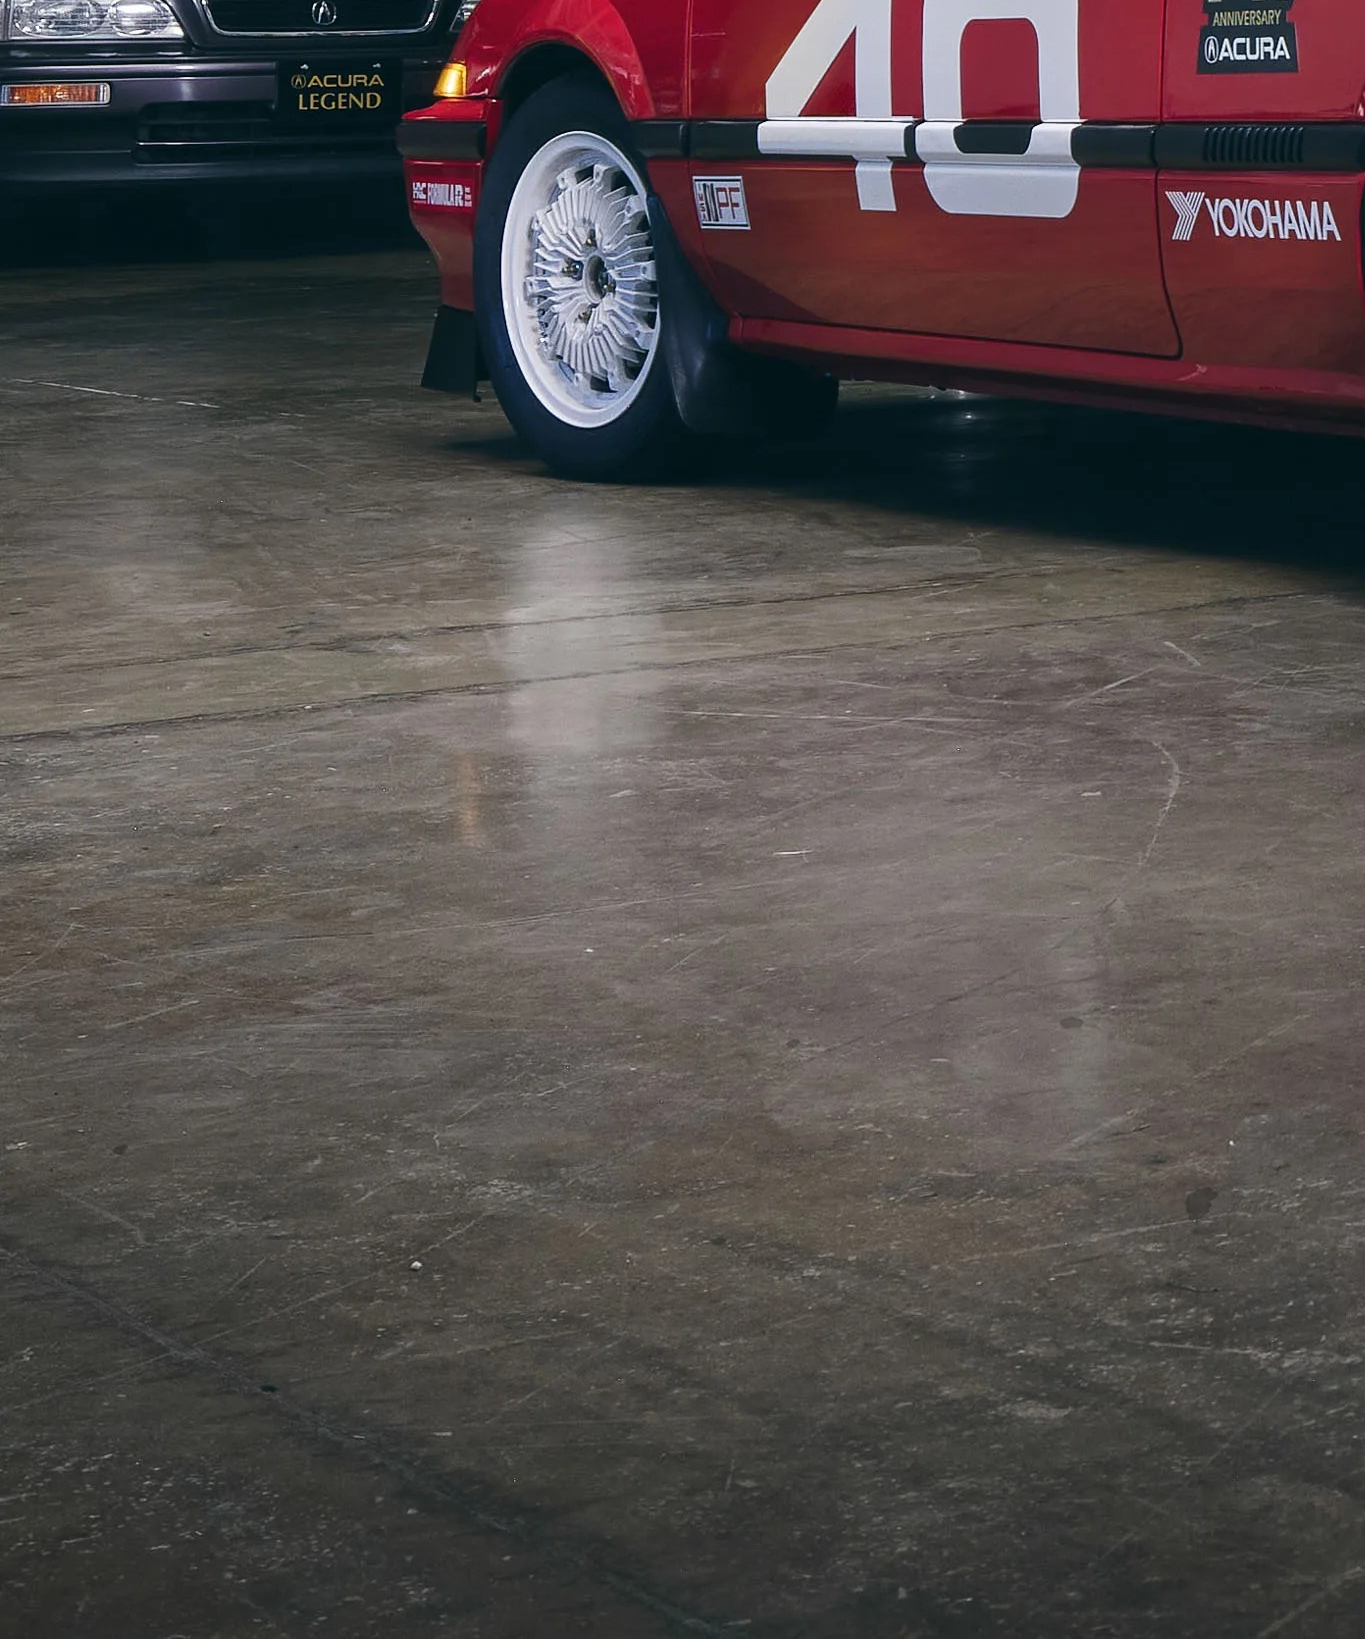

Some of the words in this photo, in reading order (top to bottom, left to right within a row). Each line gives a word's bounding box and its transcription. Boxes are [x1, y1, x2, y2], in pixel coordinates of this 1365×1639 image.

[1213, 9, 1282, 27] ANNIVERSARY
[1219, 36, 1290, 61] ACURA
[307, 74, 384, 88] ACURA
[298, 92, 382, 110] LEGEND
[1205, 198, 1341, 241] YOKOHAMA
